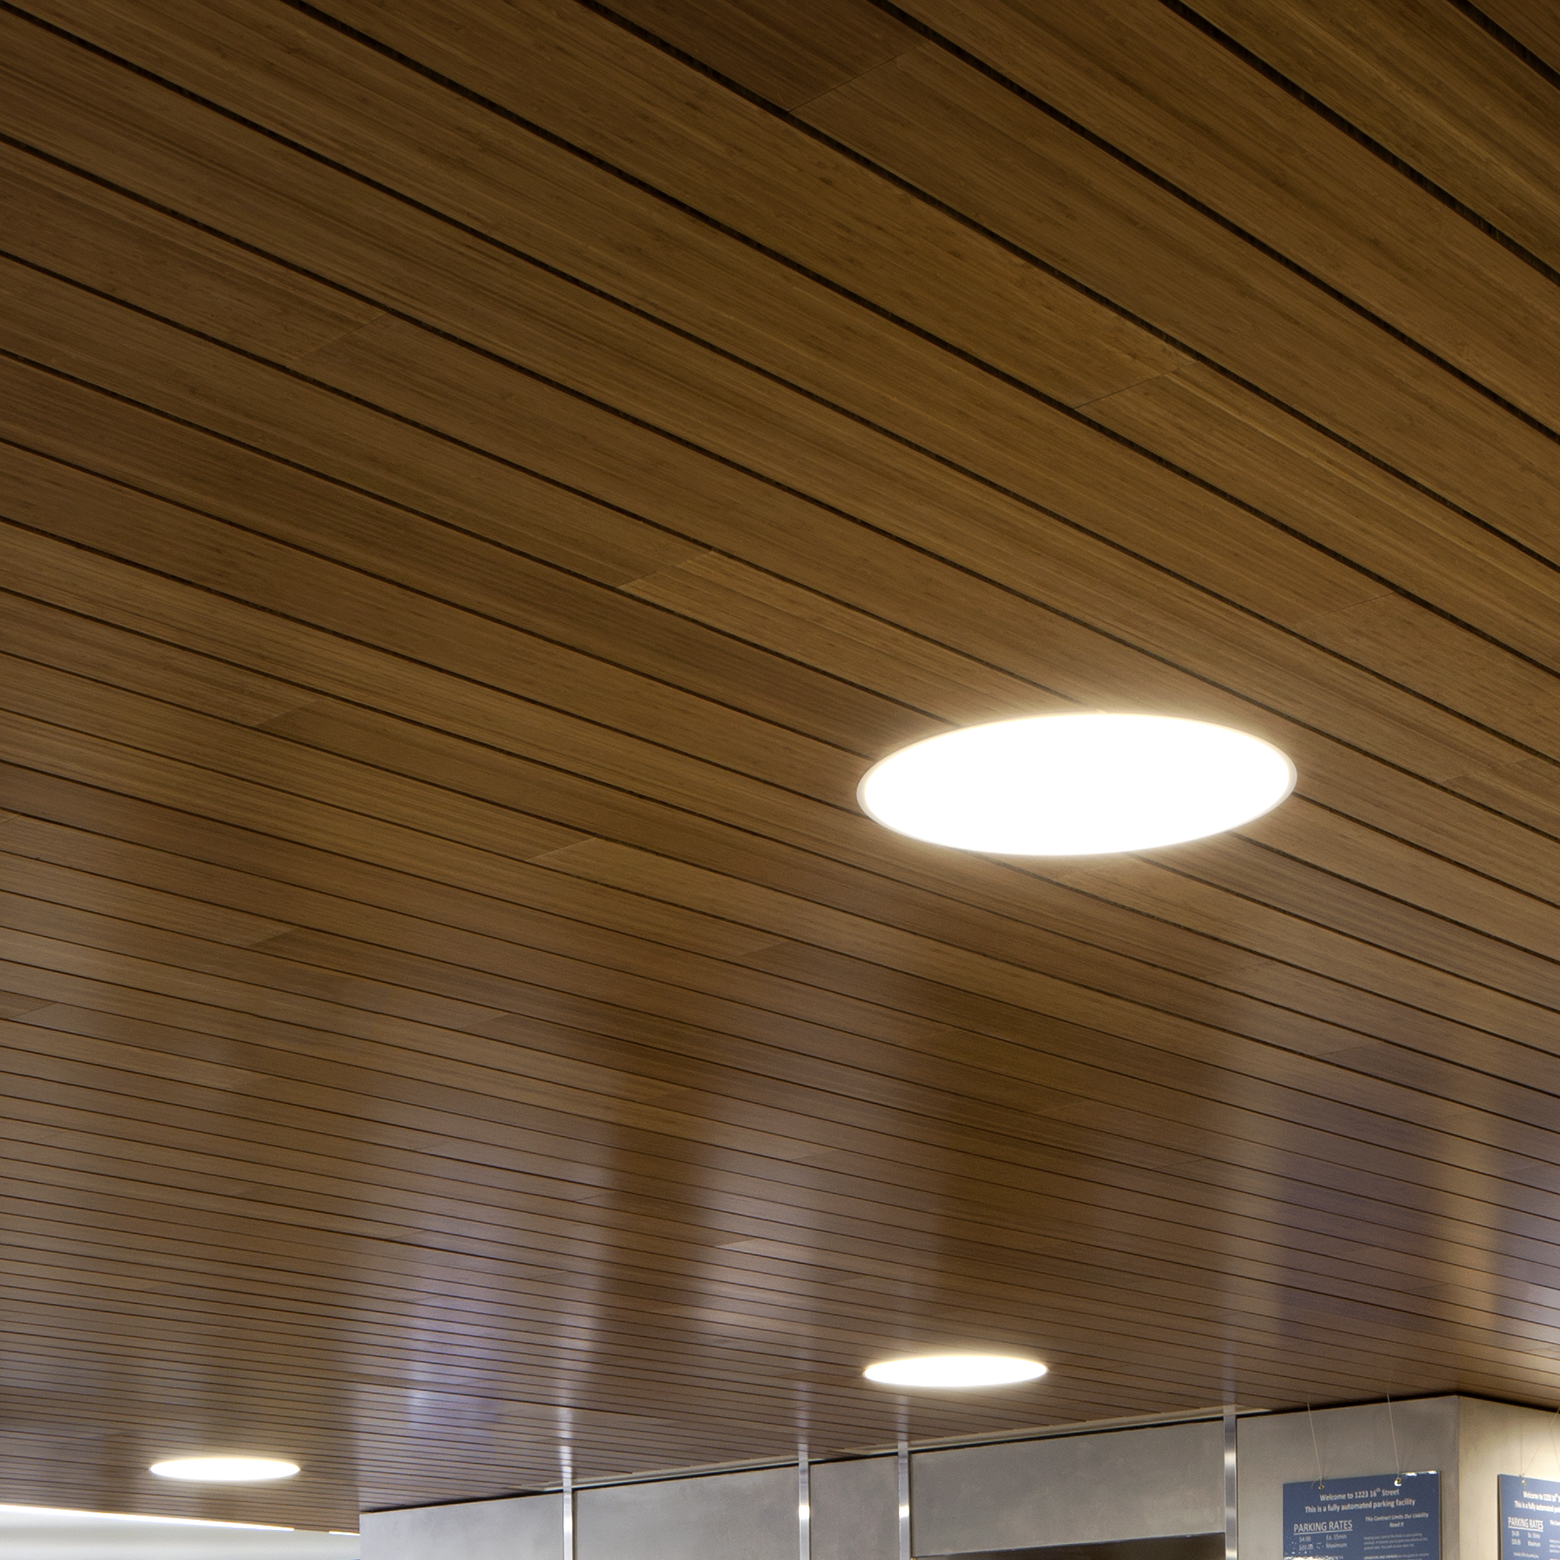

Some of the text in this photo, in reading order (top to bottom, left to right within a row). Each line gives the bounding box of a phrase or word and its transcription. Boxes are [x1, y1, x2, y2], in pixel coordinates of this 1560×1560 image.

[1320, 1493, 1346, 1501] Welcome
[1381, 1489, 1399, 1497] Street
[1305, 1505, 1316, 1513] This
[1328, 1503, 1340, 1512] fully
[1341, 1502, 1372, 1511] automated
[1373, 1500, 1395, 1509] parking
[1396, 1498, 1416, 1507] facility
[1293, 1520, 1353, 1533] PARKING RATES
